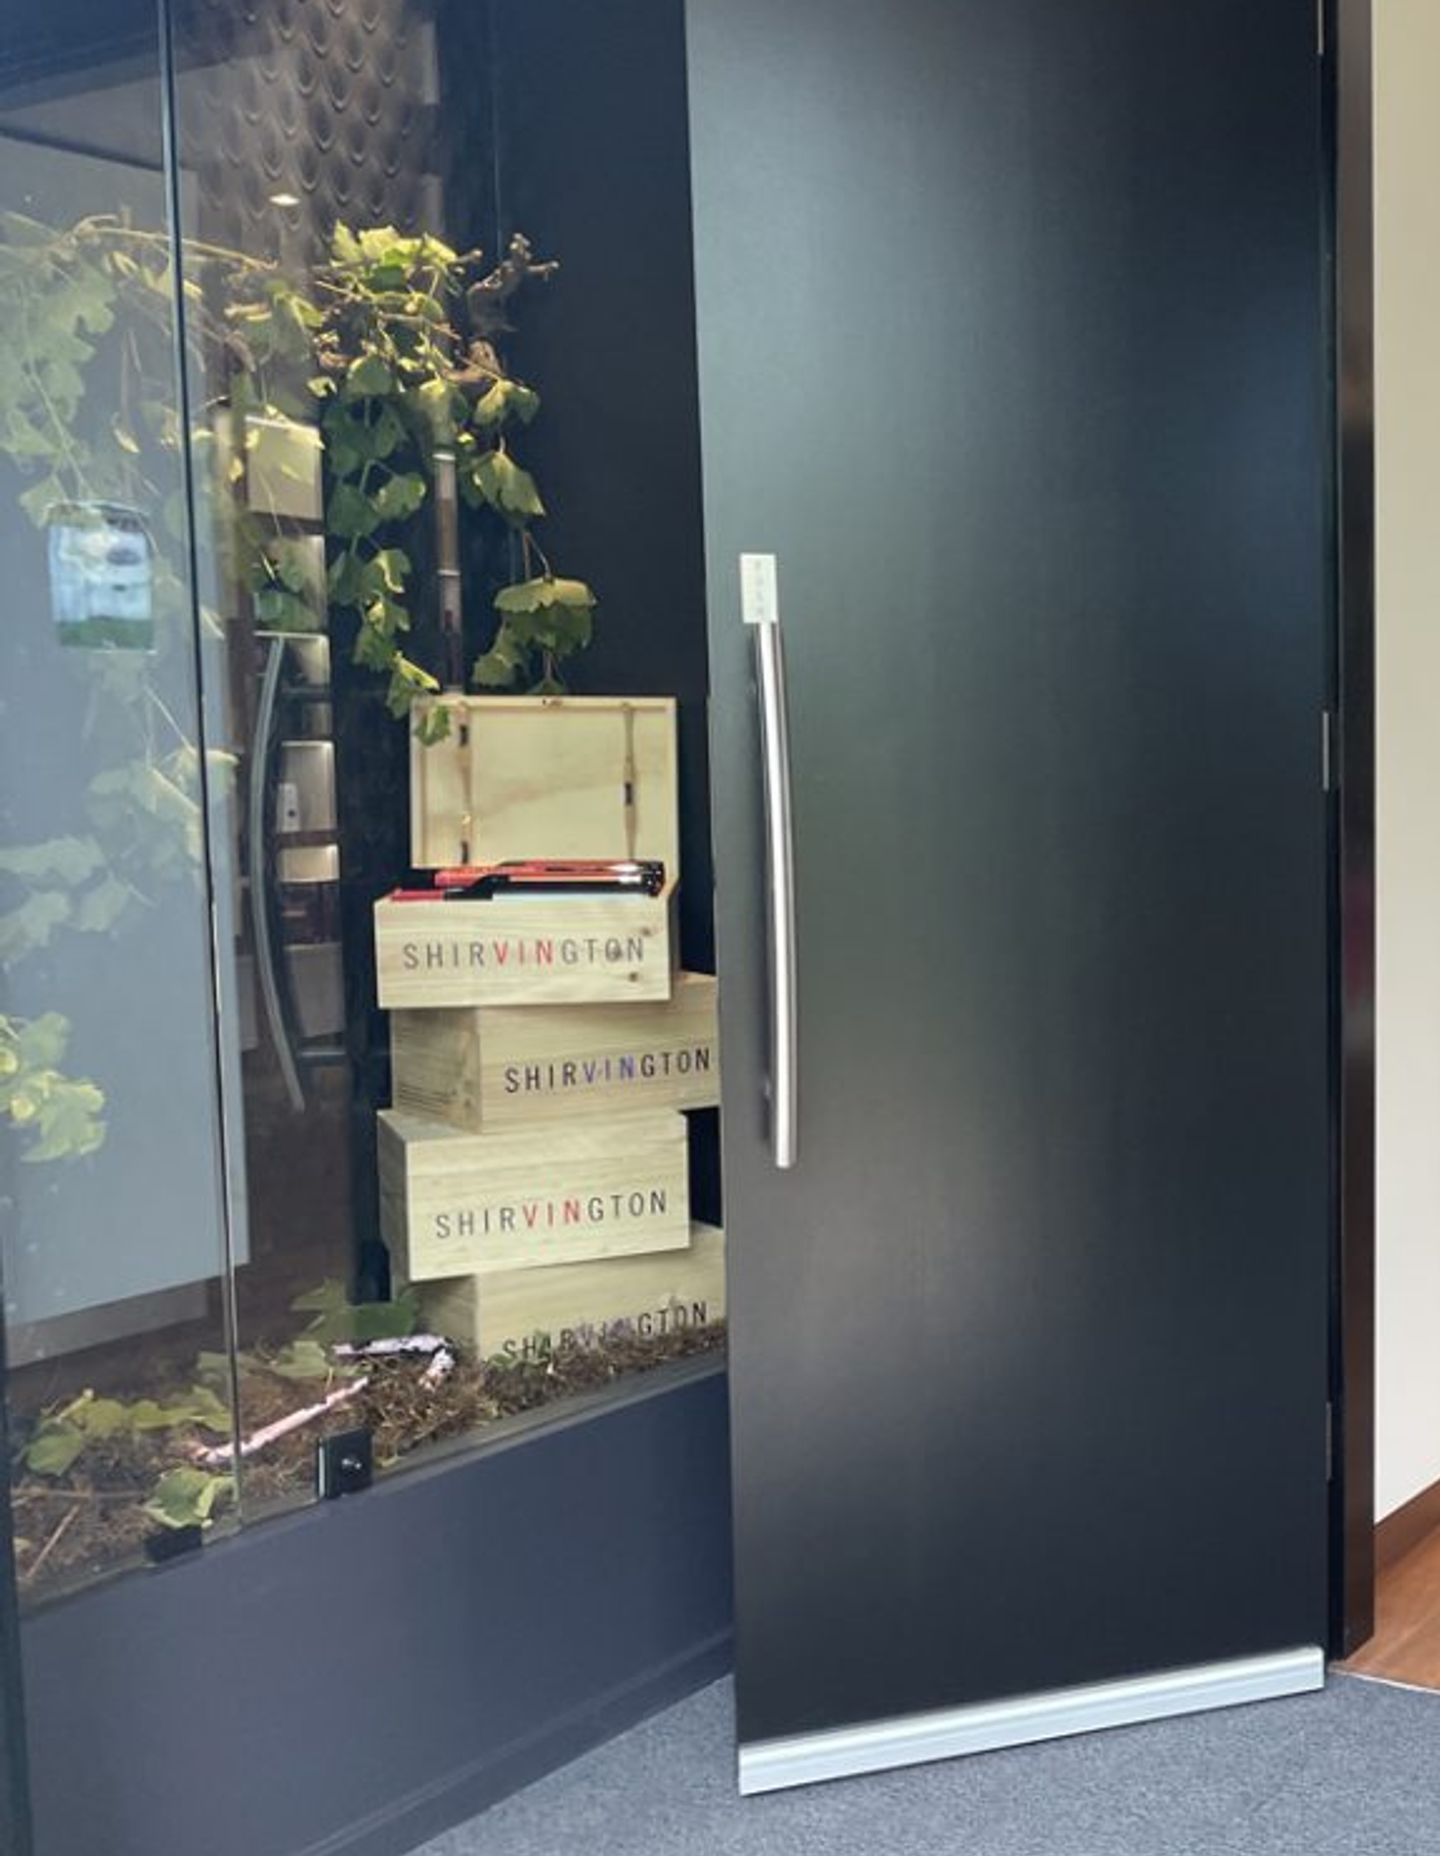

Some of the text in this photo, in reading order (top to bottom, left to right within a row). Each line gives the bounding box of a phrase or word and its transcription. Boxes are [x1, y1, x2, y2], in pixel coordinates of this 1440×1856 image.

[404, 938, 644, 970] SHIRVINGTON
[504, 1047, 710, 1093] SHIRVINGTON
[435, 1190, 667, 1239] SHIRVINGTON
